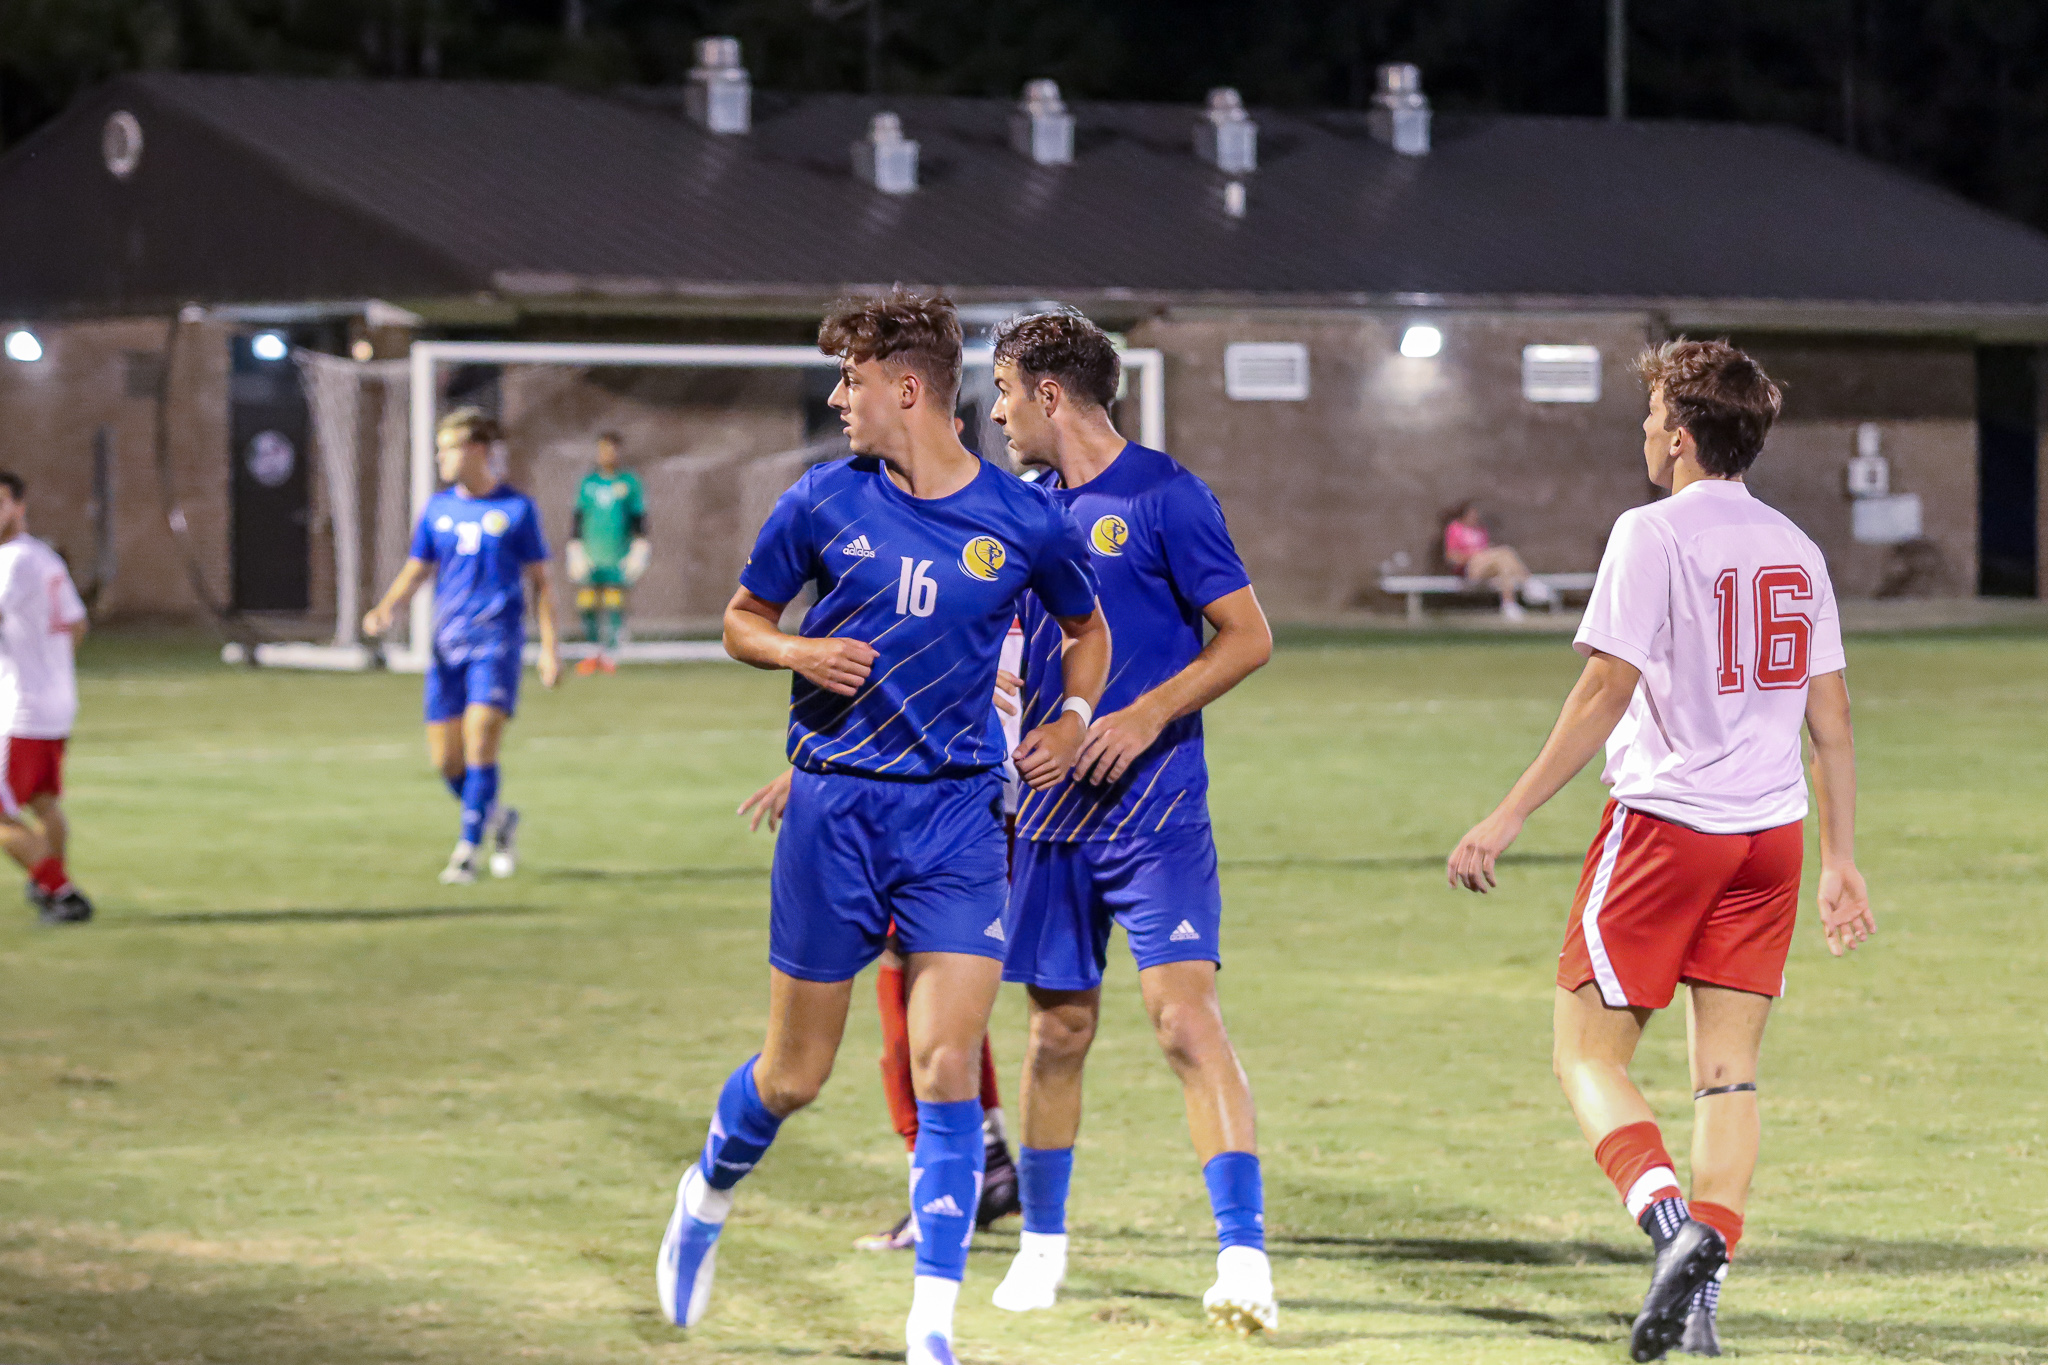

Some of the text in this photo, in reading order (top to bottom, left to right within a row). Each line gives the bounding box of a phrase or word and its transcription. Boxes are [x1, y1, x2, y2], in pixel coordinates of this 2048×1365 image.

[843, 547, 875, 558] adidas
[895, 556, 938, 618] 16
[1714, 564, 1813, 695] 16
